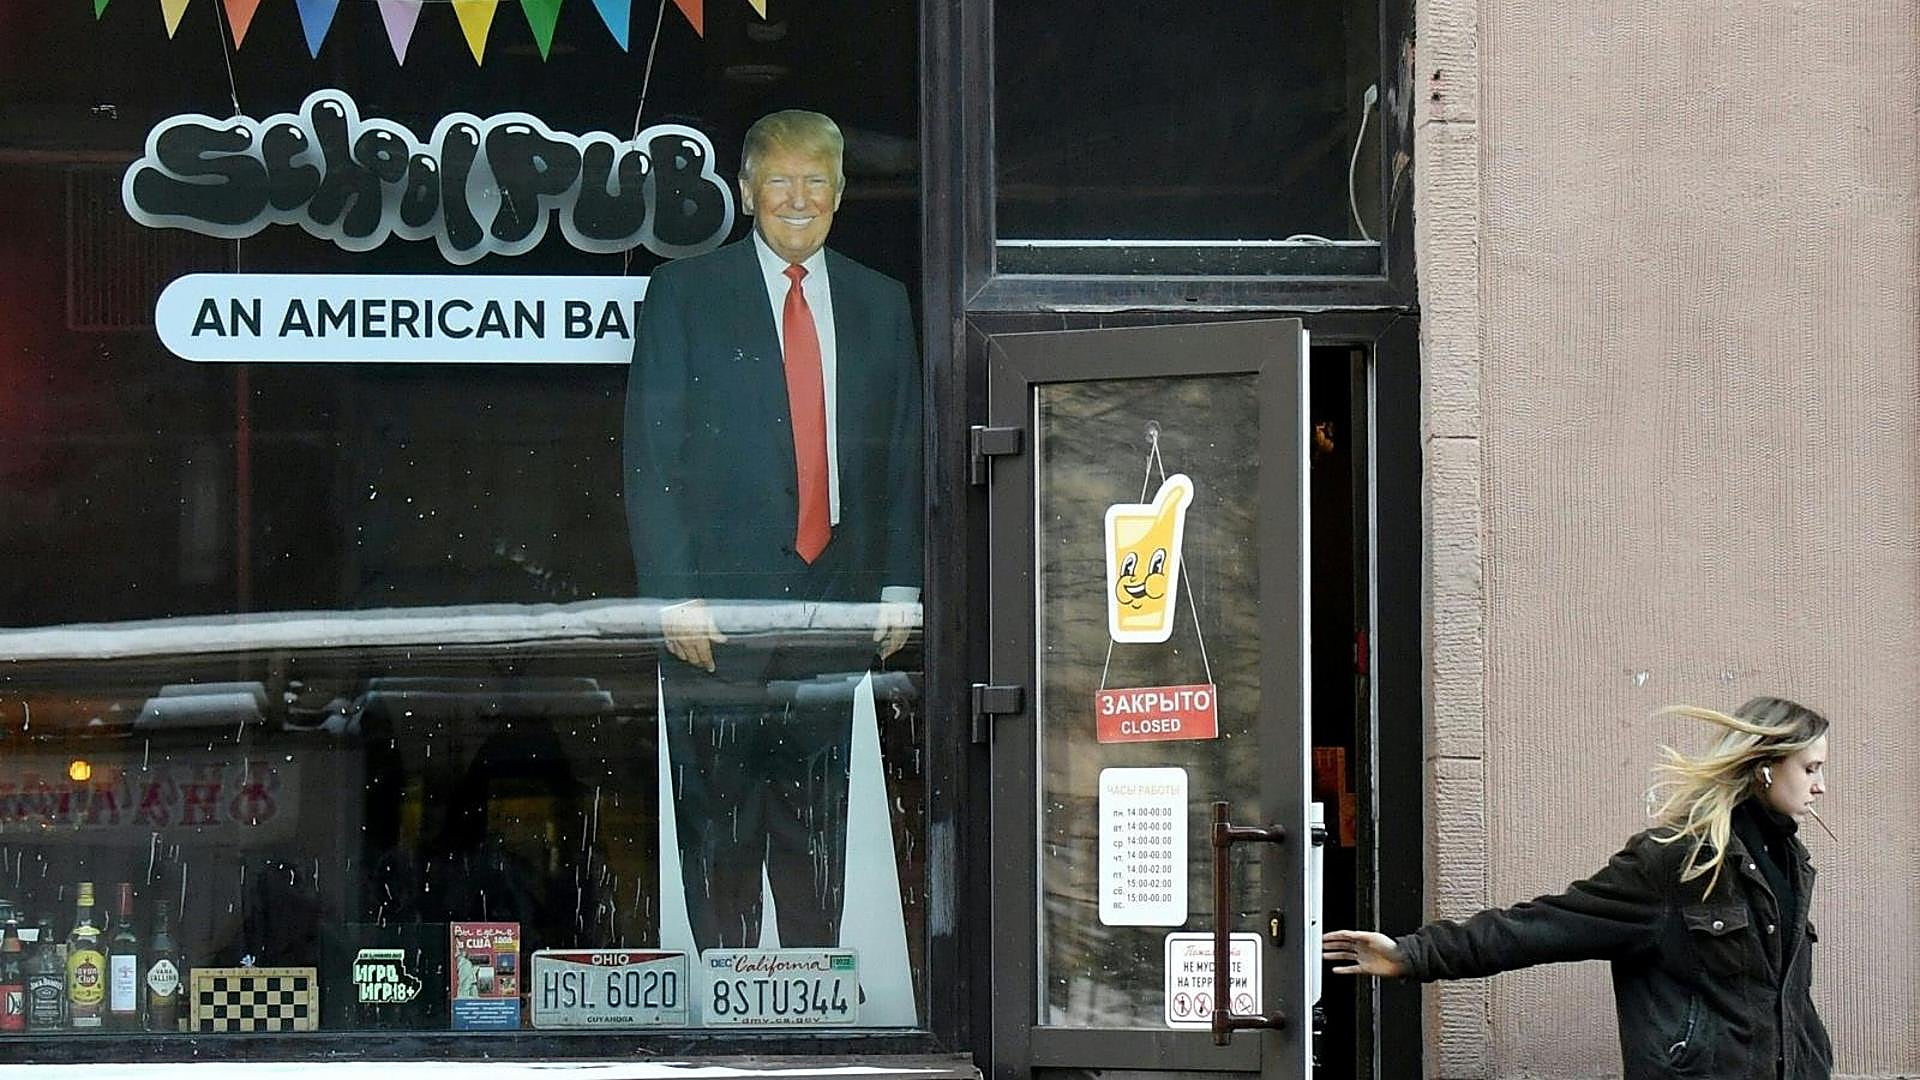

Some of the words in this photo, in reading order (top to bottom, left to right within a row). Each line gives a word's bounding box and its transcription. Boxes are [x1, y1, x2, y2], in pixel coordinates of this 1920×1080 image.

[191, 299, 262, 338] AN
[278, 299, 546, 340] AMERICAN
[1100, 689, 1211, 717] ЗАКРЫТО
[1120, 718, 1182, 735] CLOSED
[1106, 784, 1137, 797] ЧАСЫ
[1138, 784, 1181, 797] РАБОТЫ
[466, 938, 492, 949] США
[592, 954, 630, 967] OHIO
[710, 958, 733, 968] DEC
[734, 954, 830, 977] California
[1183, 961, 1194, 973] НЕ
[1196, 961, 1242, 973] МУСТЕ
[543, 971, 596, 1009] HSL
[607, 970, 677, 1009] 6020
[1177, 976, 1189, 988] НА
[1192, 976, 1248, 988] ТЕРРРИИ
[393, 983, 415, 1000] 18+
[713, 979, 848, 1016] 8STU344
